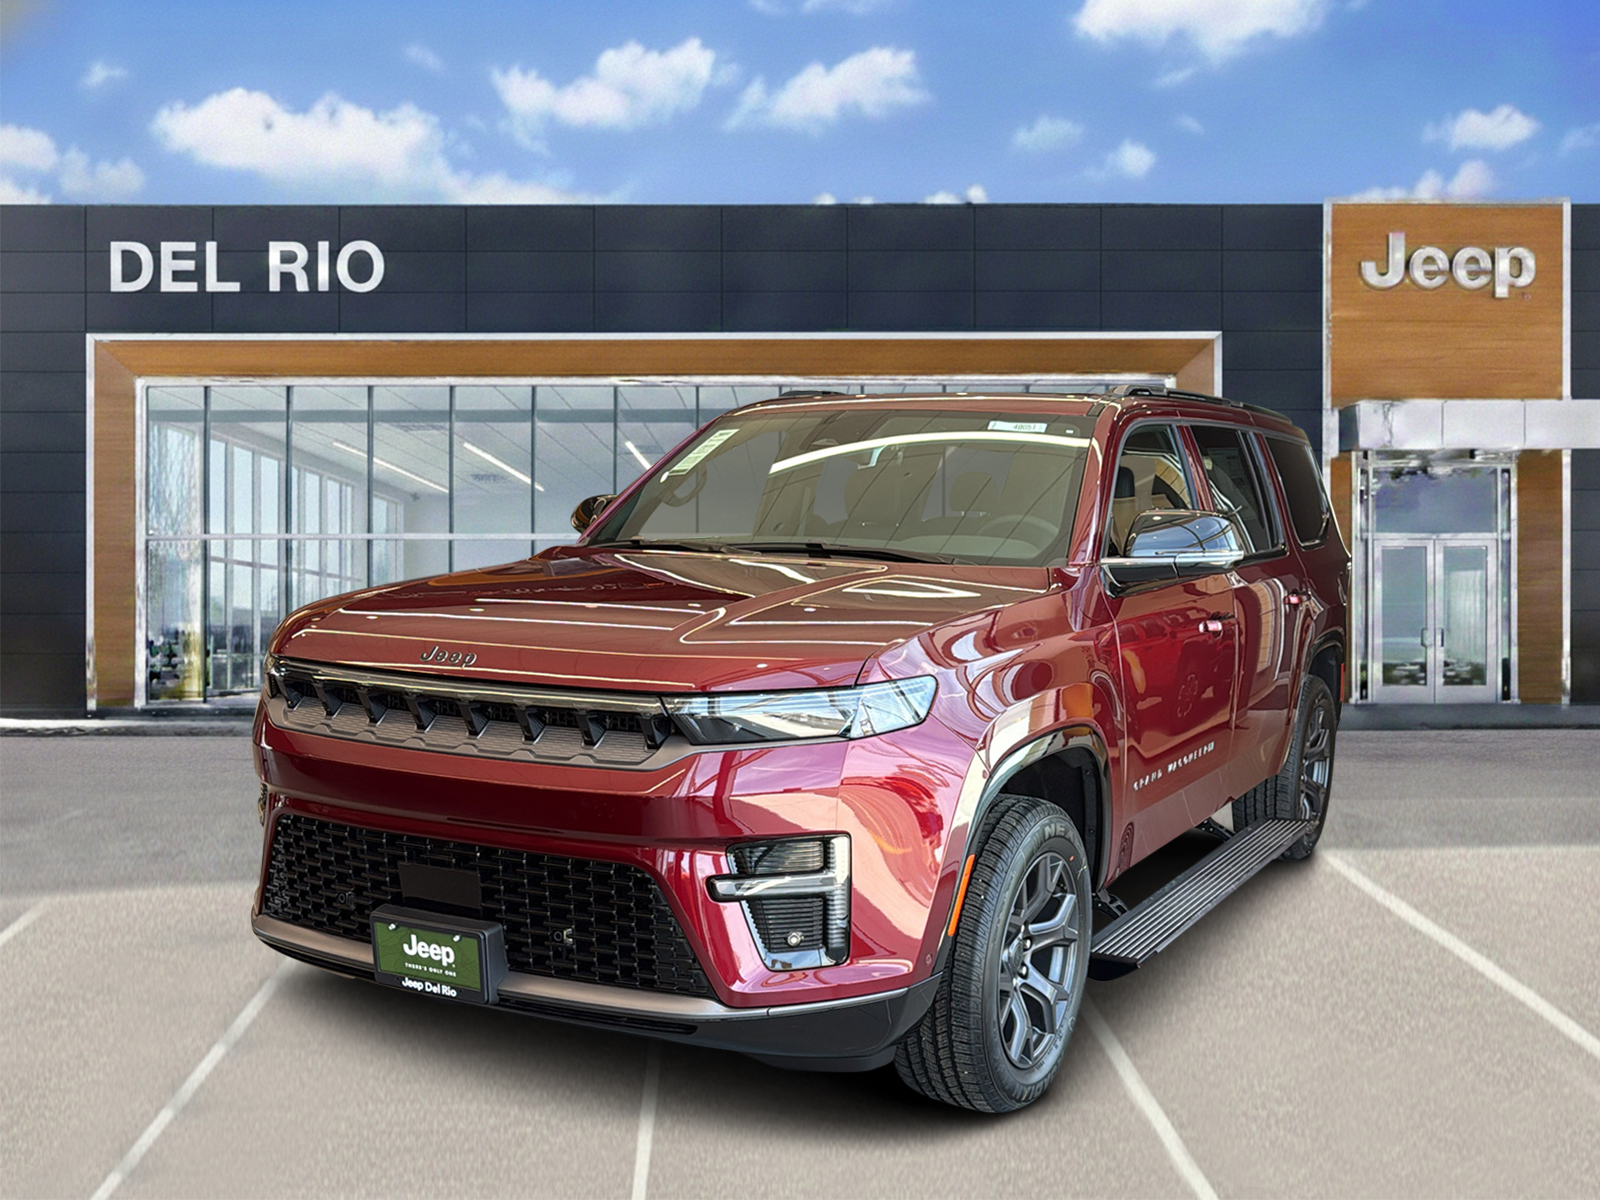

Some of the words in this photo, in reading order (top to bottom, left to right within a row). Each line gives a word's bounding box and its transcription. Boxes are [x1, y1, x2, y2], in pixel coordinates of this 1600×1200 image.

[110, 241, 241, 292] DEL
[268, 240, 385, 293] RIO
[1360, 231, 1537, 299] Jeep
[420, 645, 478, 668] Jeep
[402, 934, 455, 967] Jeep
[428, 967, 443, 975] ONLY
[401, 977, 424, 991] Jeep
[424, 981, 441, 994] Del
[441, 984, 457, 997] Rio
